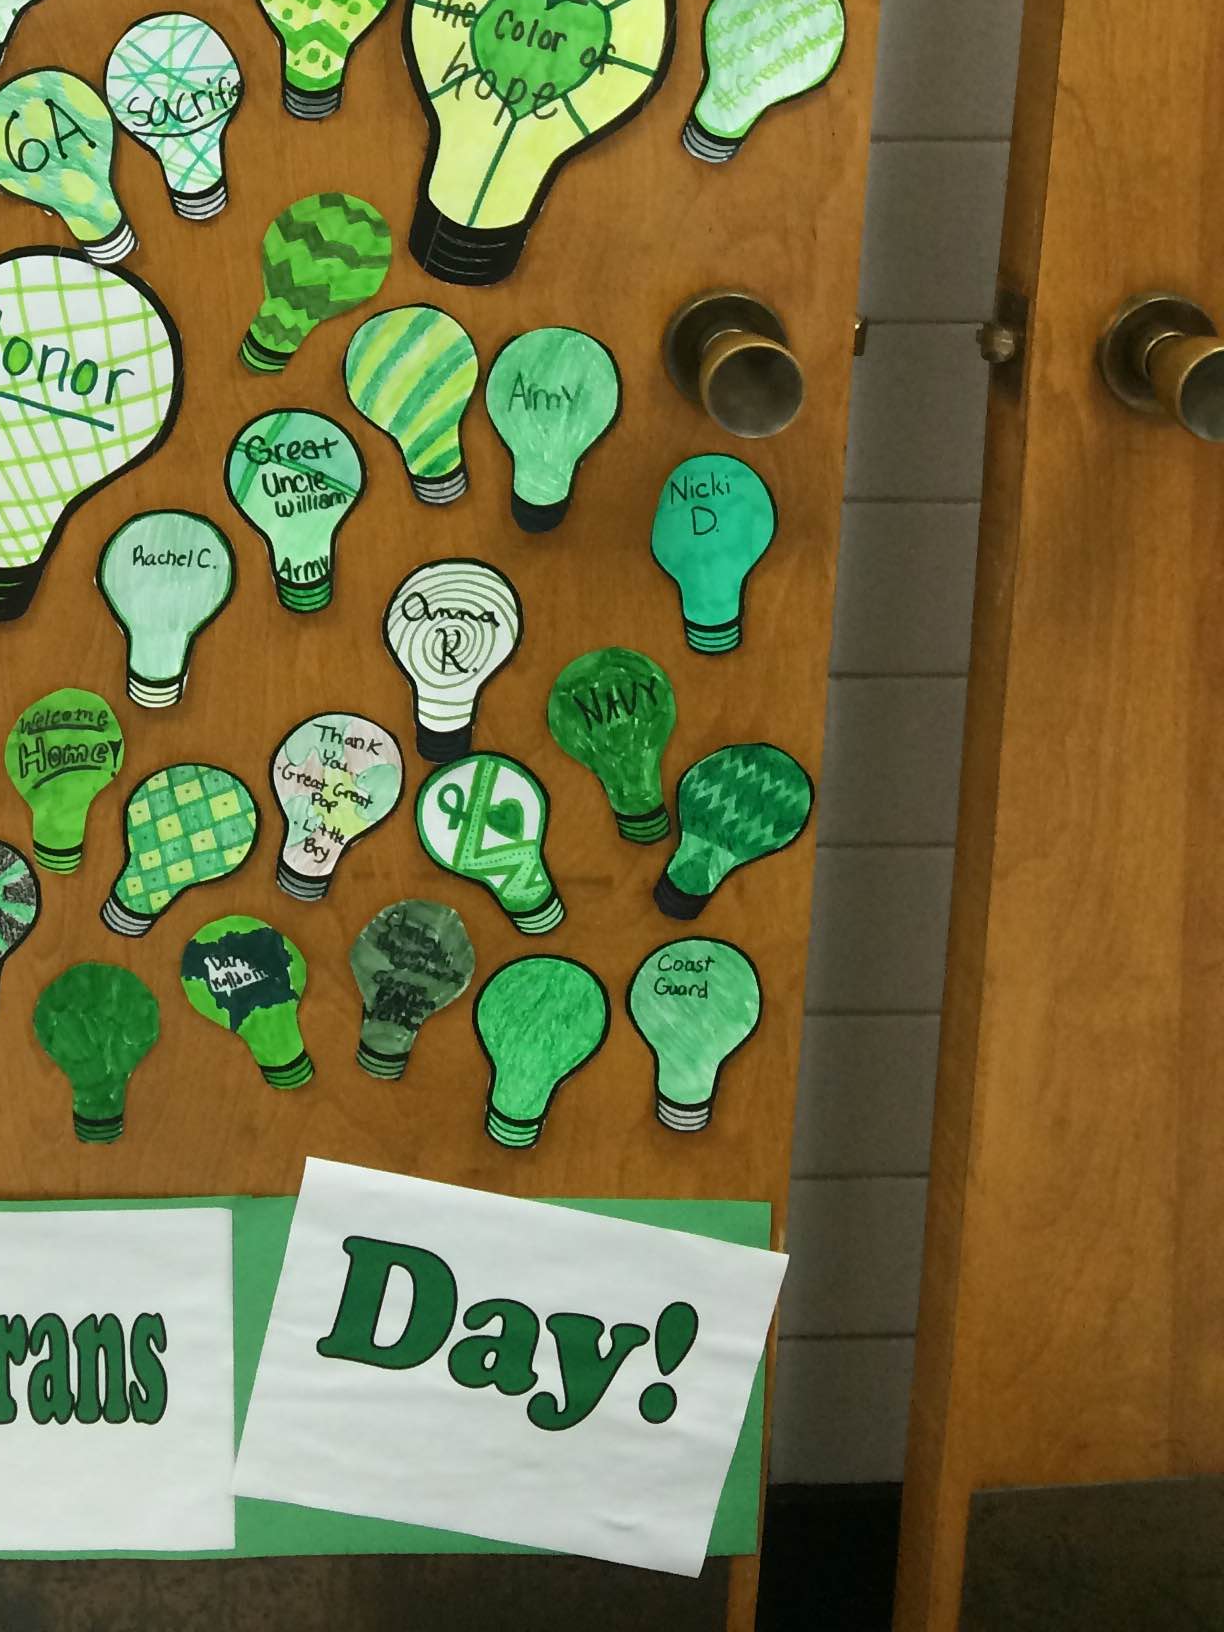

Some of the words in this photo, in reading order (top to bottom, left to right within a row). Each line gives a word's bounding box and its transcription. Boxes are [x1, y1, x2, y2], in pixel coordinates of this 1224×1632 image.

[578, 42, 616, 76] of
[507, 371, 584, 414] Army
[243, 433, 341, 466] Great
[261, 470, 330, 497] Uncle
[669, 472, 732, 505] Nicki
[690, 506, 720, 537] D.
[132, 545, 195, 571] Rachel
[197, 548, 218, 571] C.
[401, 591, 501, 628] Anna
[282, 763, 329, 792] Great
[332, 782, 374, 810] Great
[656, 953, 716, 974] Coast
[653, 975, 711, 1001] Guard
[316, 1235, 699, 1432] Day!
